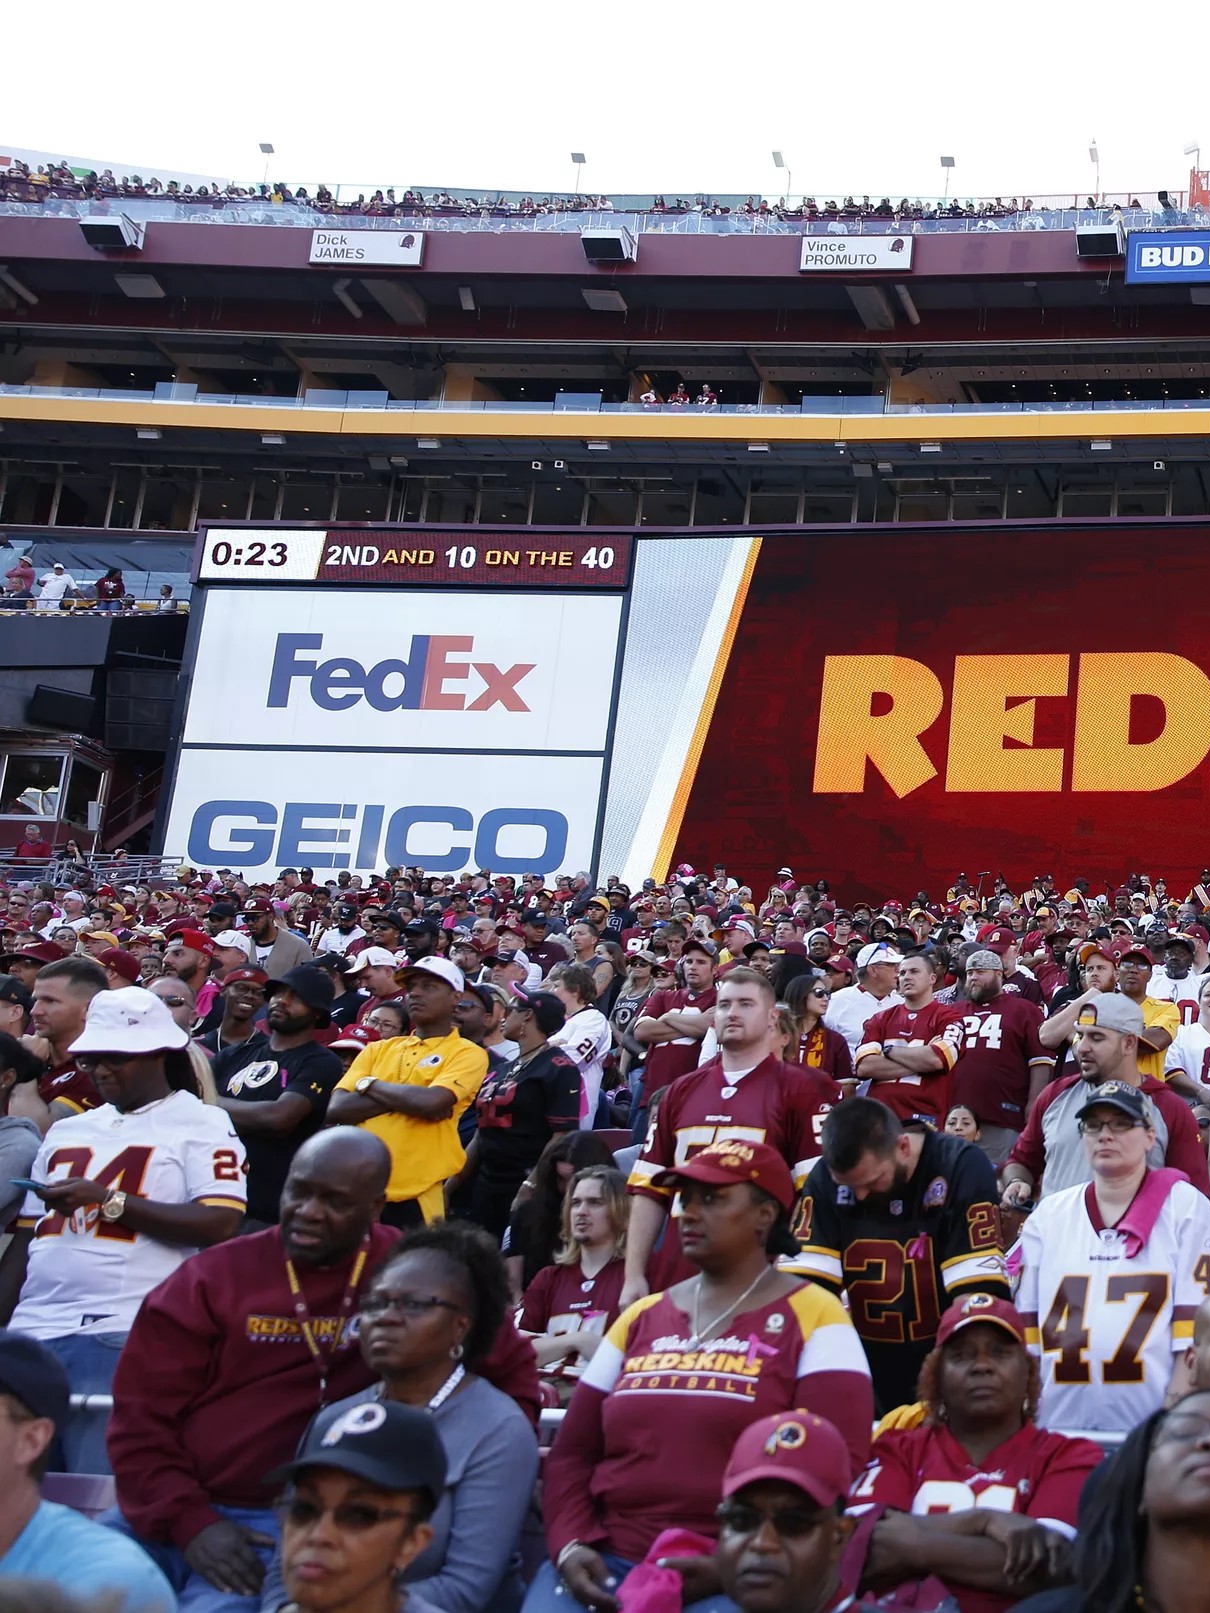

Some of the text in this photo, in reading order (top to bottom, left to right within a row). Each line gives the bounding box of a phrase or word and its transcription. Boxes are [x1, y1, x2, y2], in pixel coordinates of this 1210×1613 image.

[316, 234, 348, 245] Dick
[807, 241, 846, 251] Vince
[315, 248, 365, 259] JAMES
[805, 254, 877, 265] PROMUTO
[1141, 246, 1205, 268] BUD
[211, 541, 288, 567] 0:23
[326, 545, 615, 569] 2ND AND 10 ON THE 40
[267, 632, 537, 712] FedEx
[188, 800, 568, 875] GEICO
[965, 1013, 1003, 1050] 24
[844, 1235, 941, 1343] 21
[1041, 1272, 1173, 1384] 47
[624, 1352, 763, 1377] REDSKINS
[616, 1376, 757, 1396] FOOTBALL
